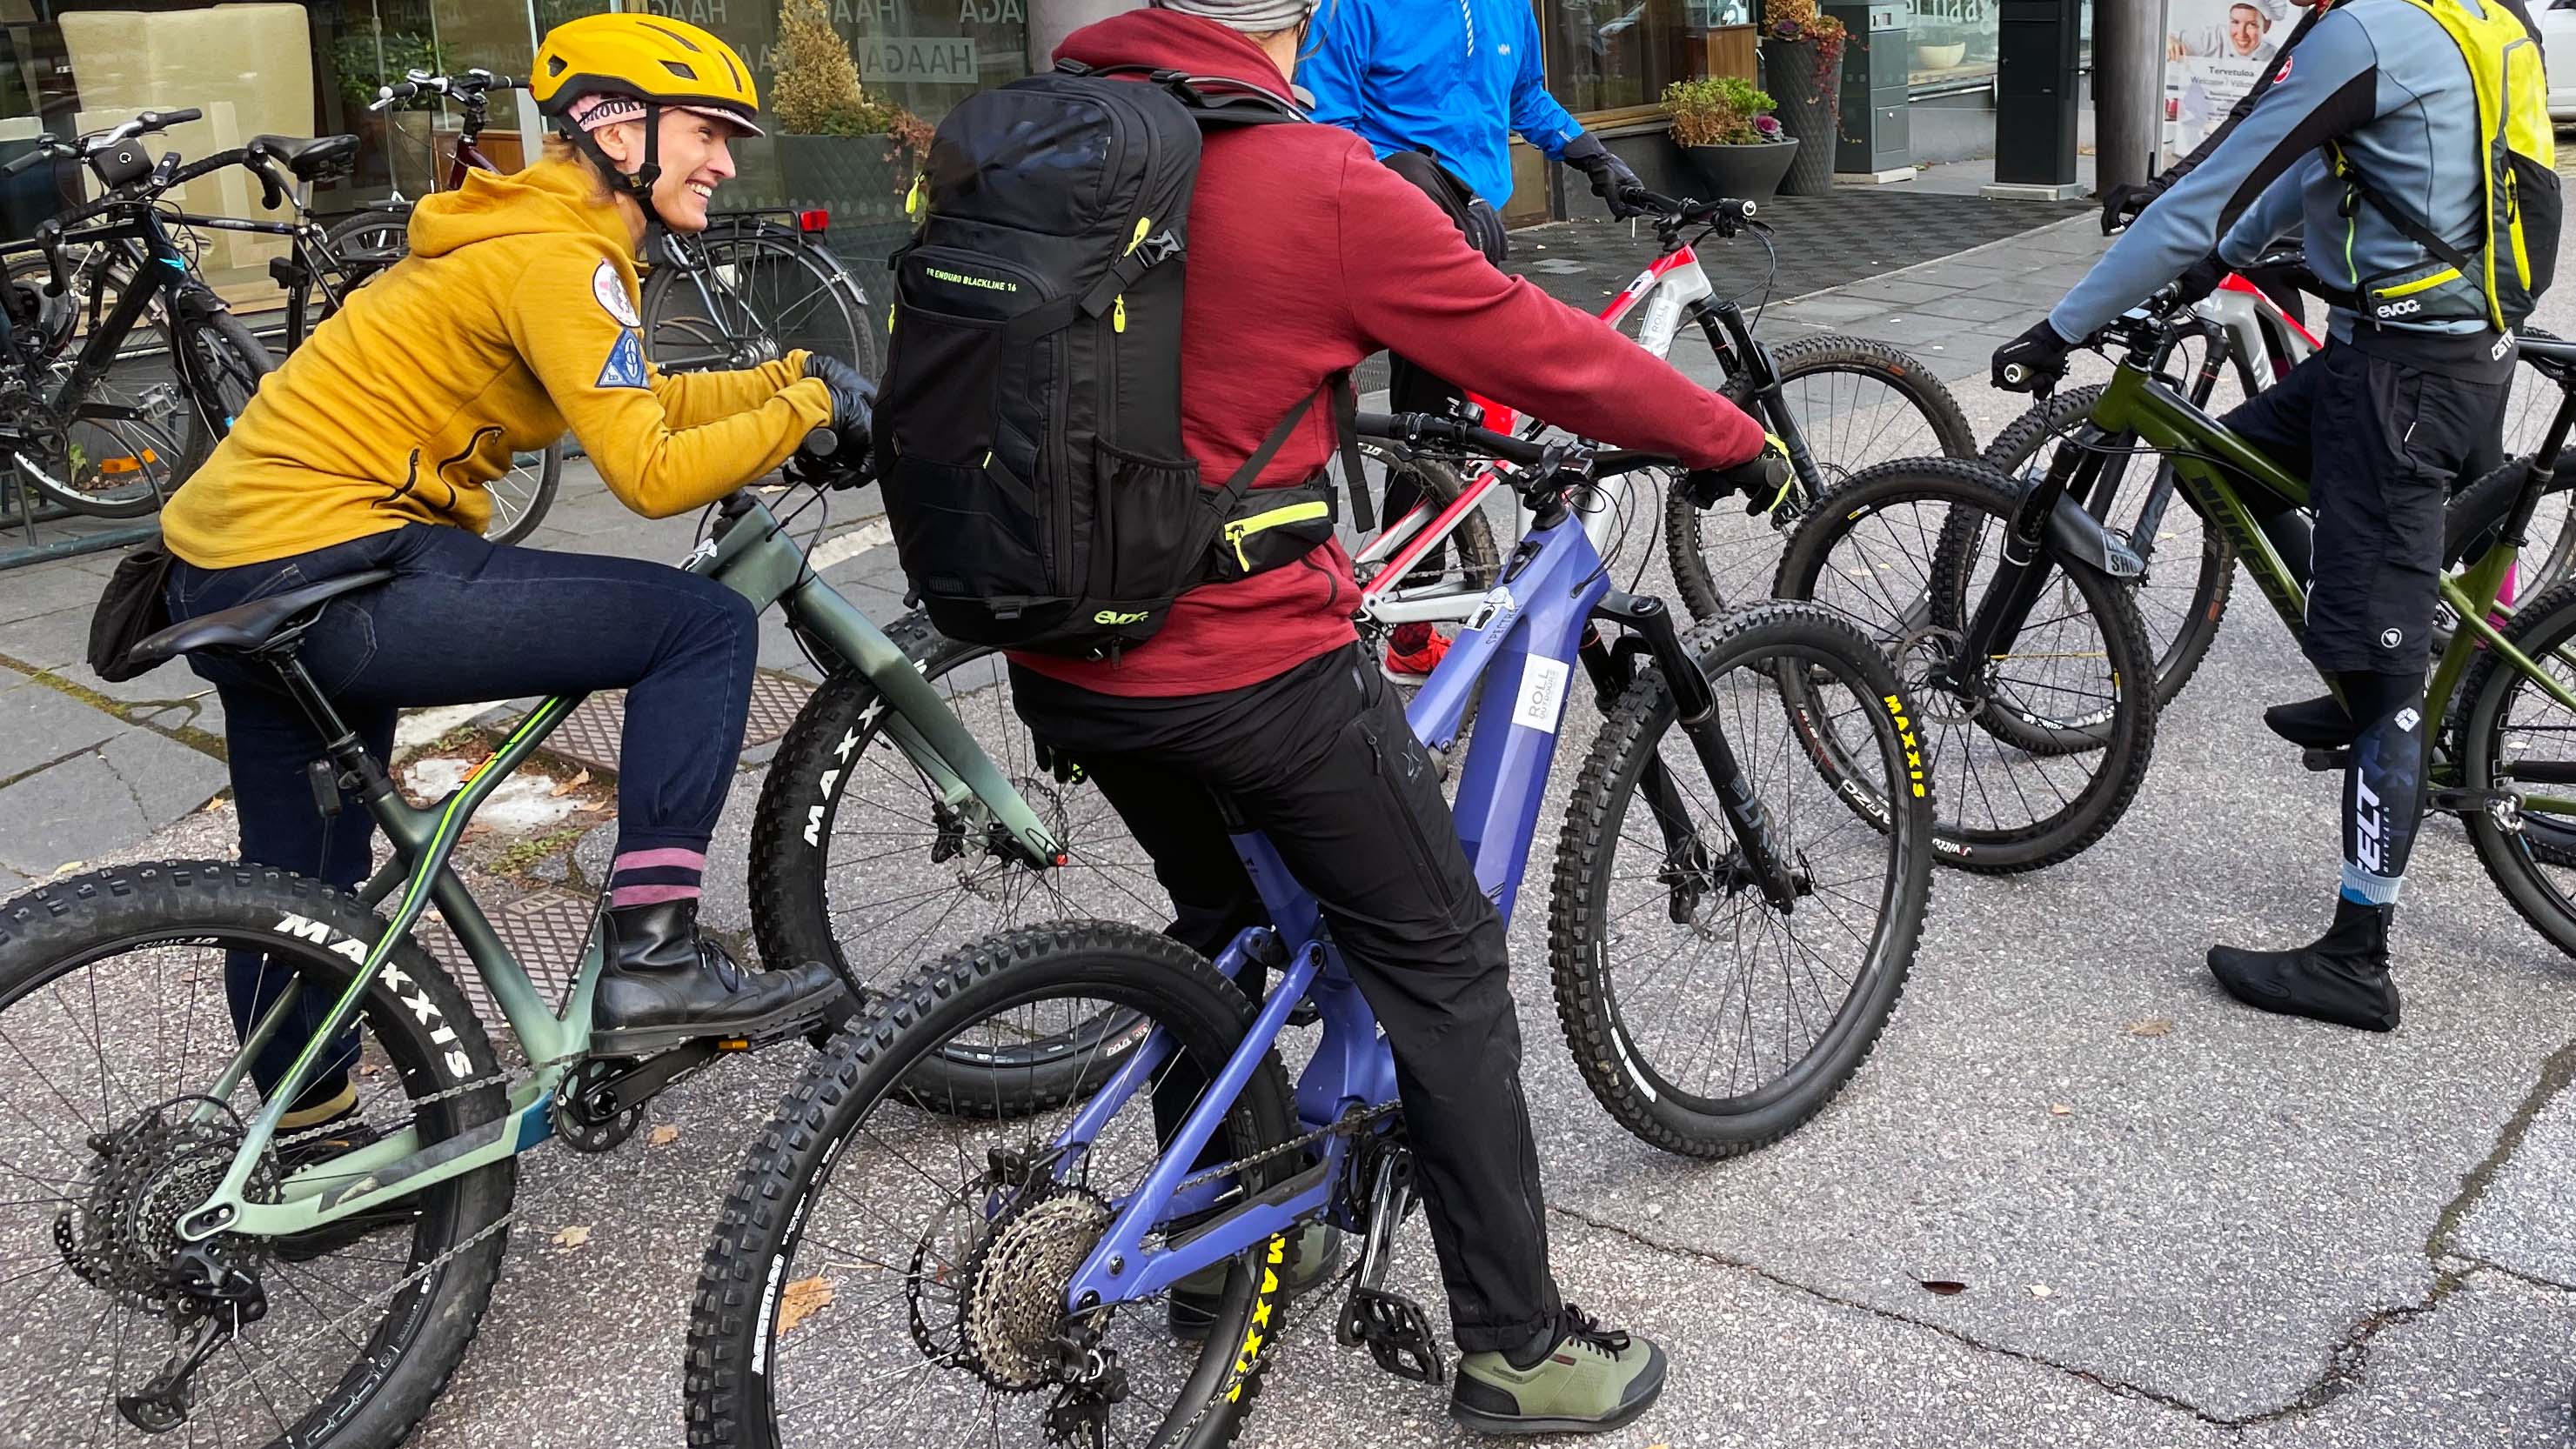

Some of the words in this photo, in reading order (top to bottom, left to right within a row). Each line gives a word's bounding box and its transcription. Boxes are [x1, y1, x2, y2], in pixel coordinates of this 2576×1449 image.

[934, 270, 962, 284] ENDURO
[962, 276, 1006, 290] BLACKLINE
[1007, 283, 1017, 292] 16
[1528, 668, 1551, 718] ROLL
[1883, 694, 1925, 798] MAXXIS
[1842, 778, 1890, 825] ARZO
[272, 910, 474, 1079] MAXXIS
[1225, 1232, 1286, 1405] MAXXIS
